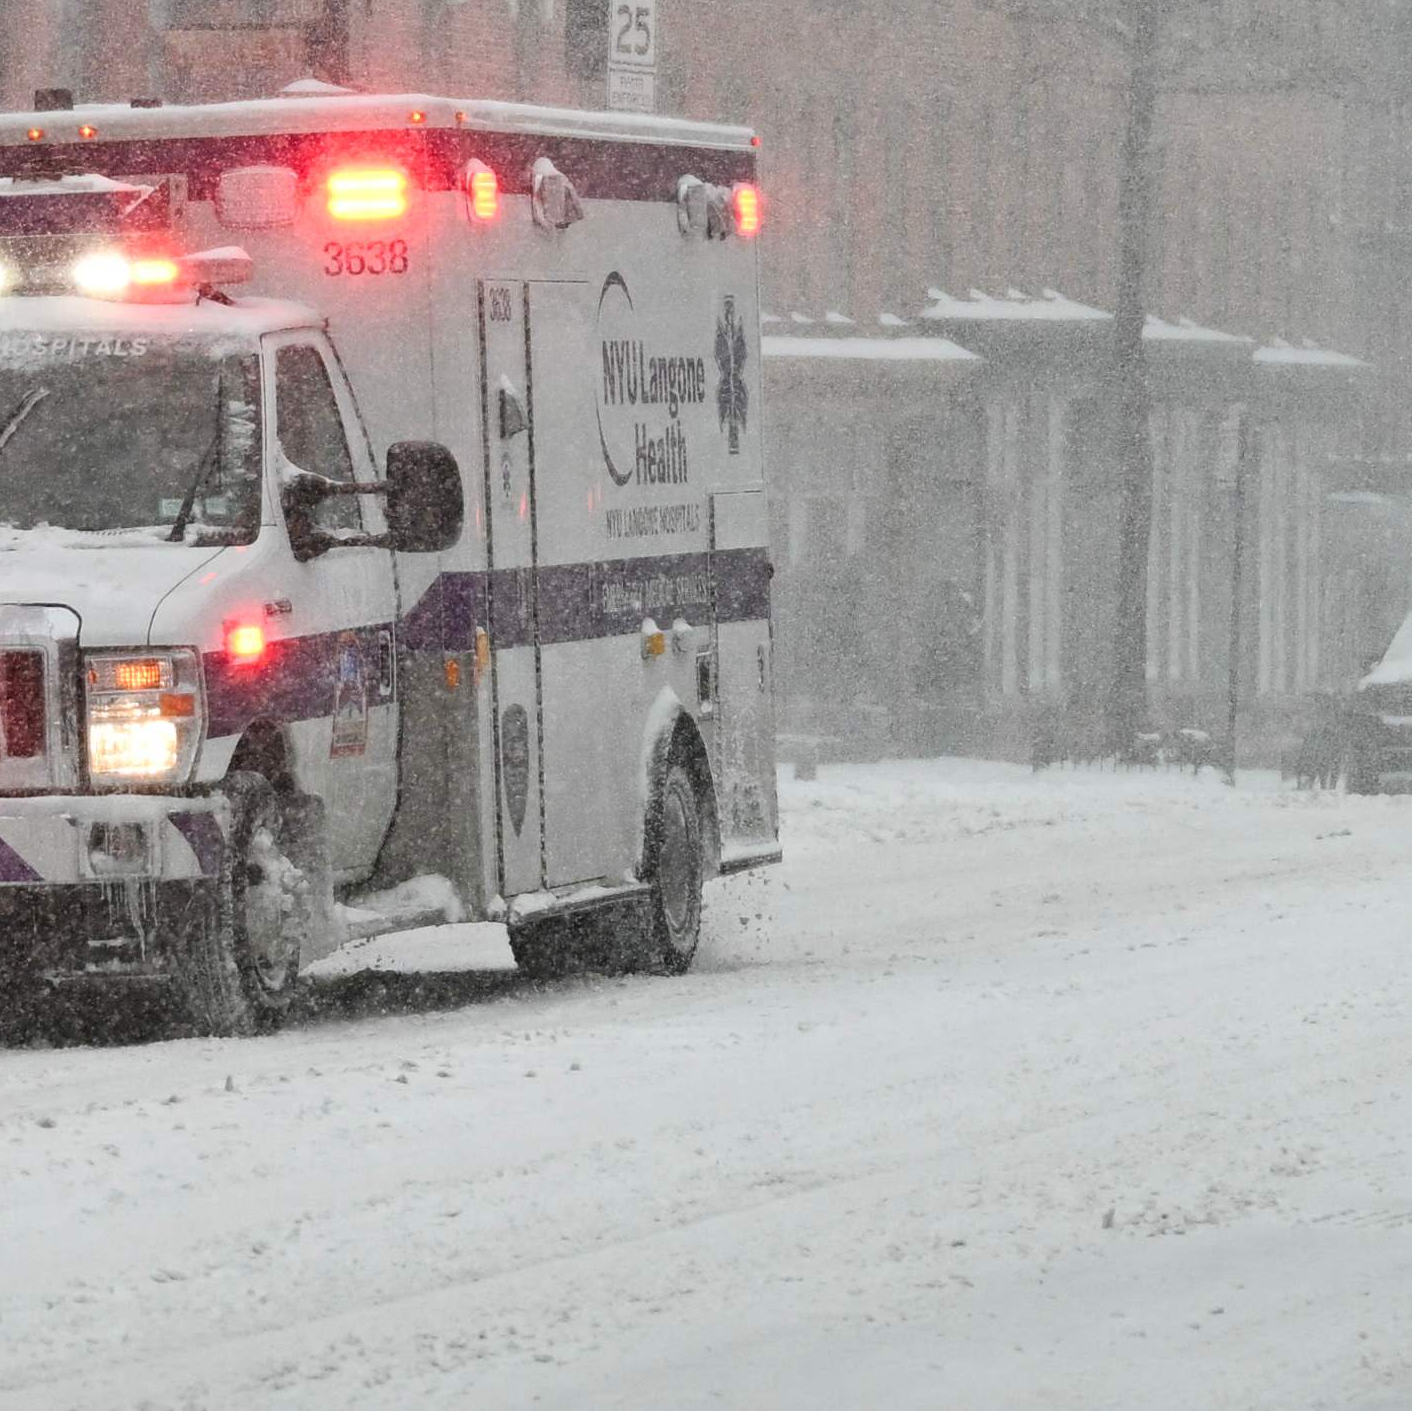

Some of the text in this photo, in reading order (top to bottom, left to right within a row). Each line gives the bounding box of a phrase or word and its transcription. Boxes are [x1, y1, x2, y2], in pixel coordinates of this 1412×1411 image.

[616, 4, 651, 56] 25
[323, 239, 409, 277] 3638
[489, 287, 512, 322] 3638
[601, 340, 706, 419] NYU Langone
[635, 420, 688, 486] Health
